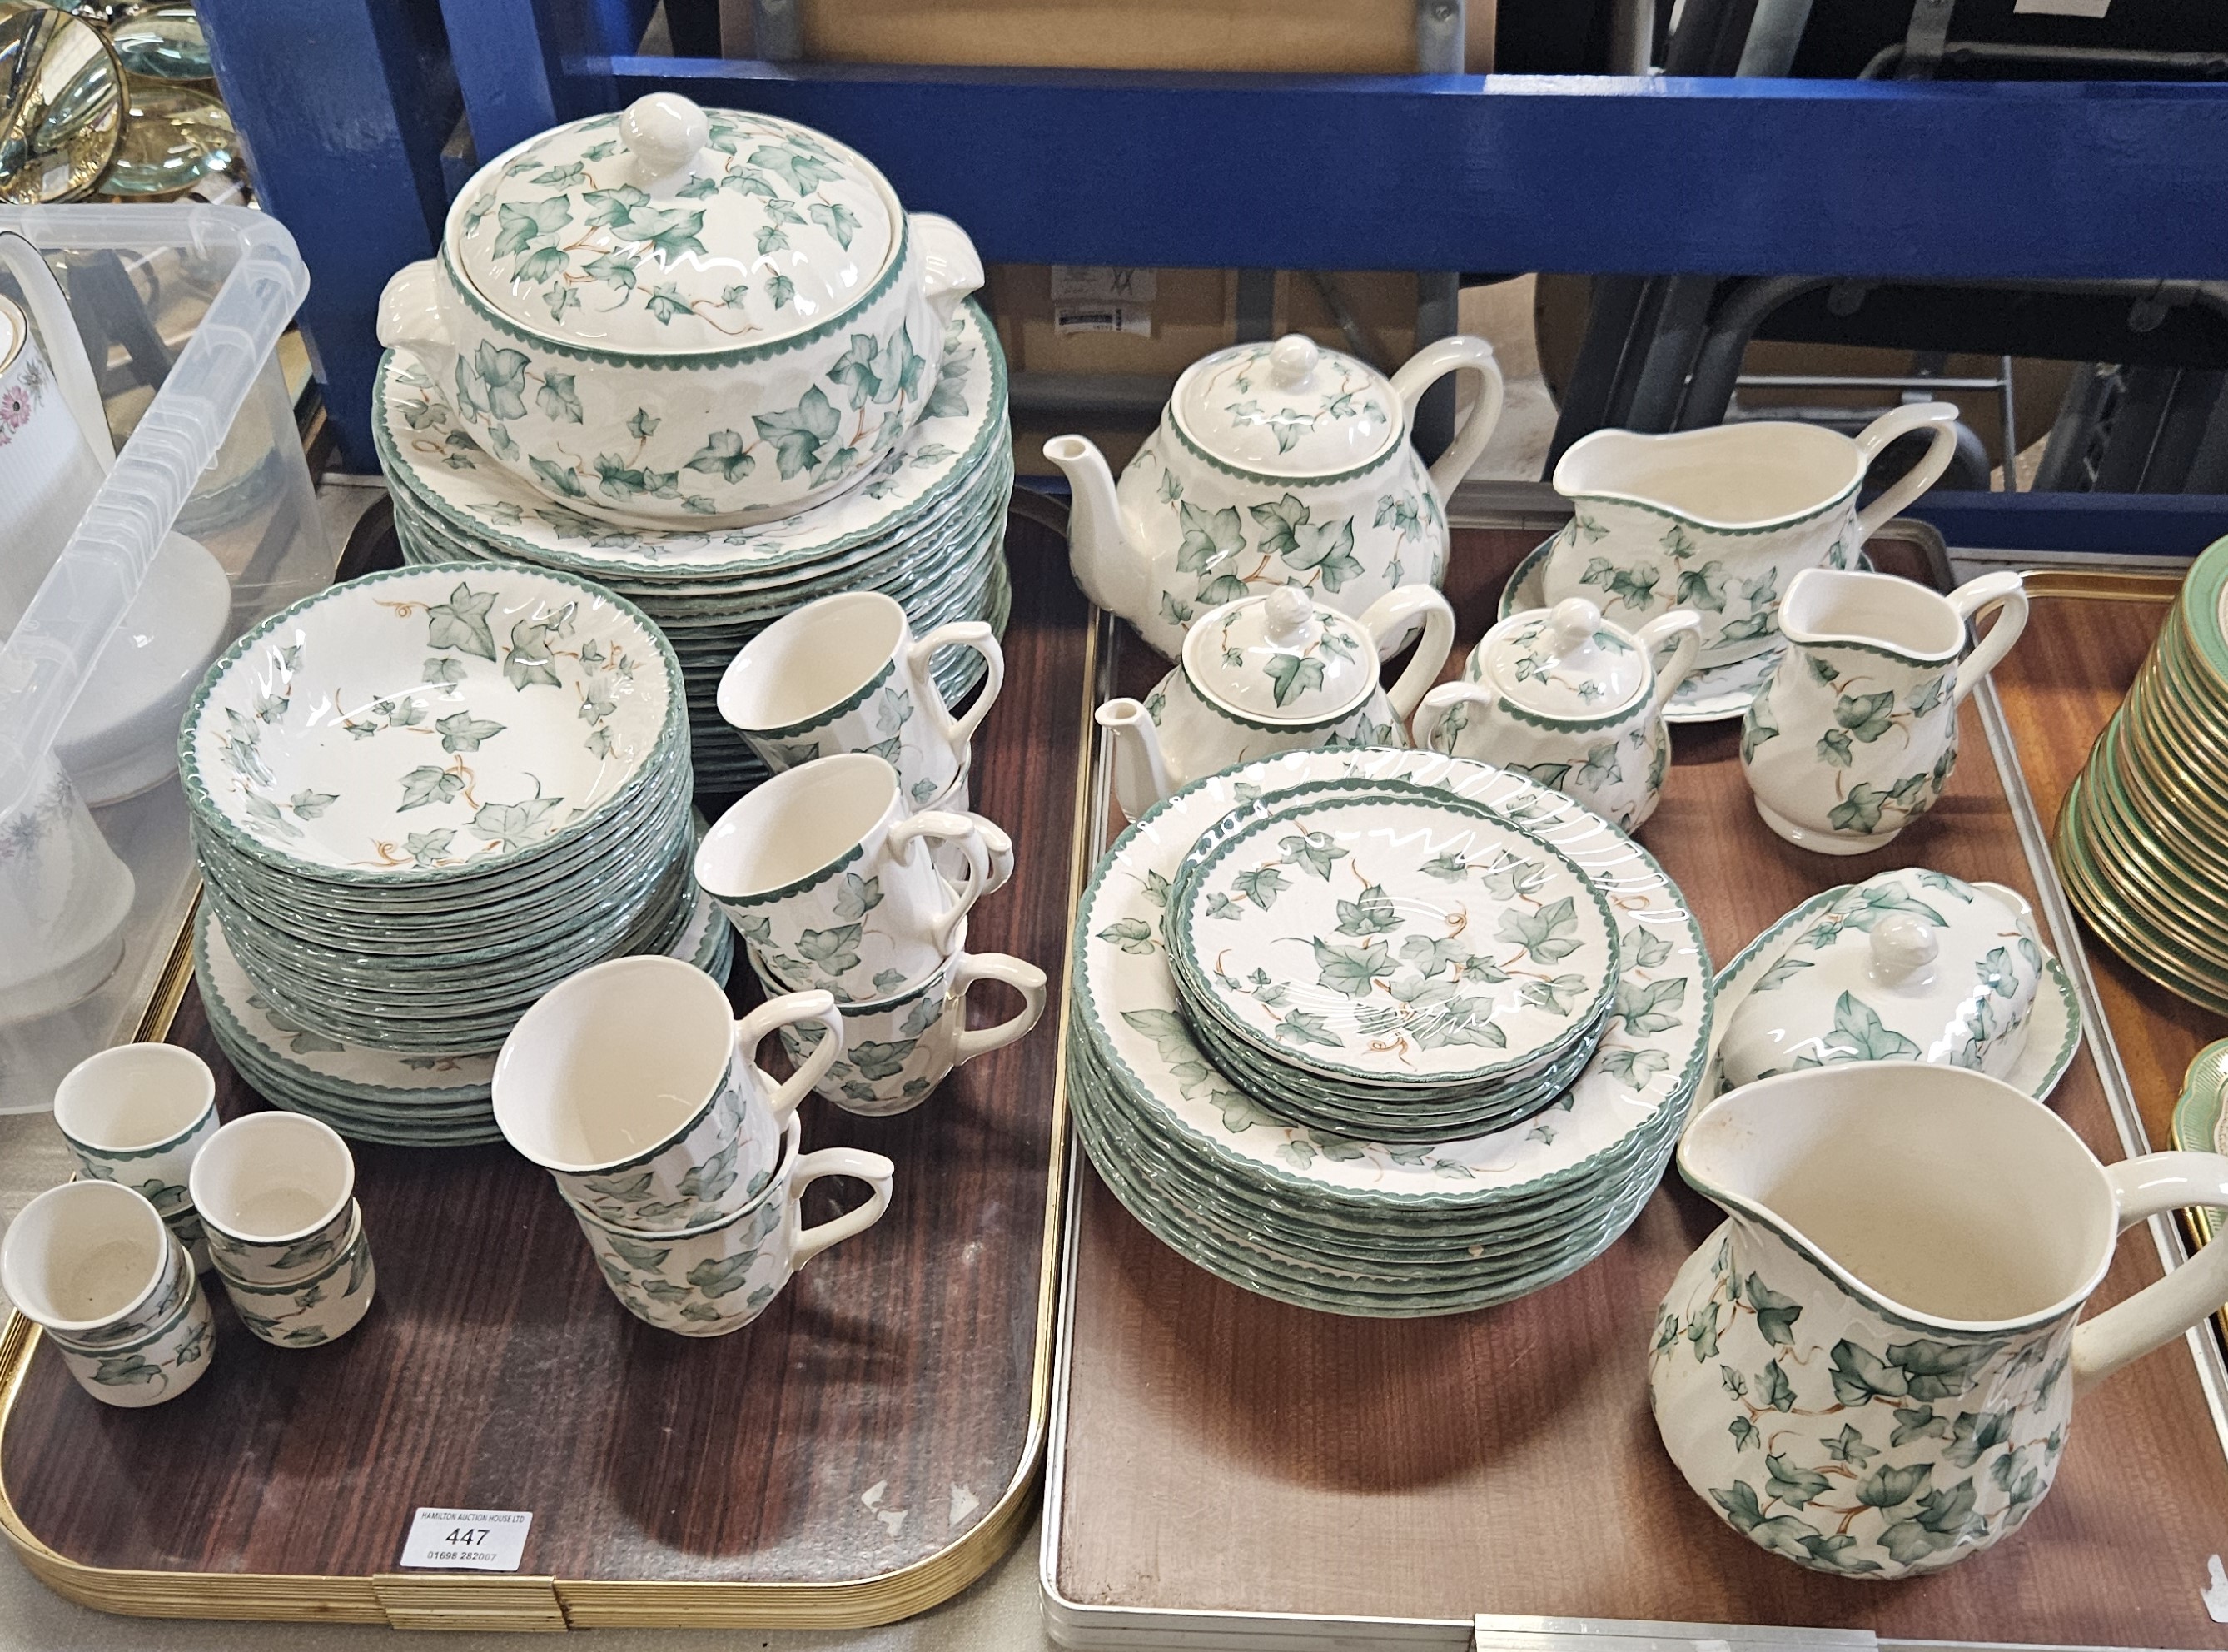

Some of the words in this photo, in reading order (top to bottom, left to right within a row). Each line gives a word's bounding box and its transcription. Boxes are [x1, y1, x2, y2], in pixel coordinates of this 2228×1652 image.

[421, 1511, 456, 1521] HAMILTON
[457, 1513, 487, 1522] AUCTION
[488, 1514, 511, 1523] HOUSE
[512, 1515, 525, 1524] LTD
[445, 1527, 491, 1546] 447
[426, 1550, 458, 1560] 01698
[460, 1551, 497, 1562] 282007
